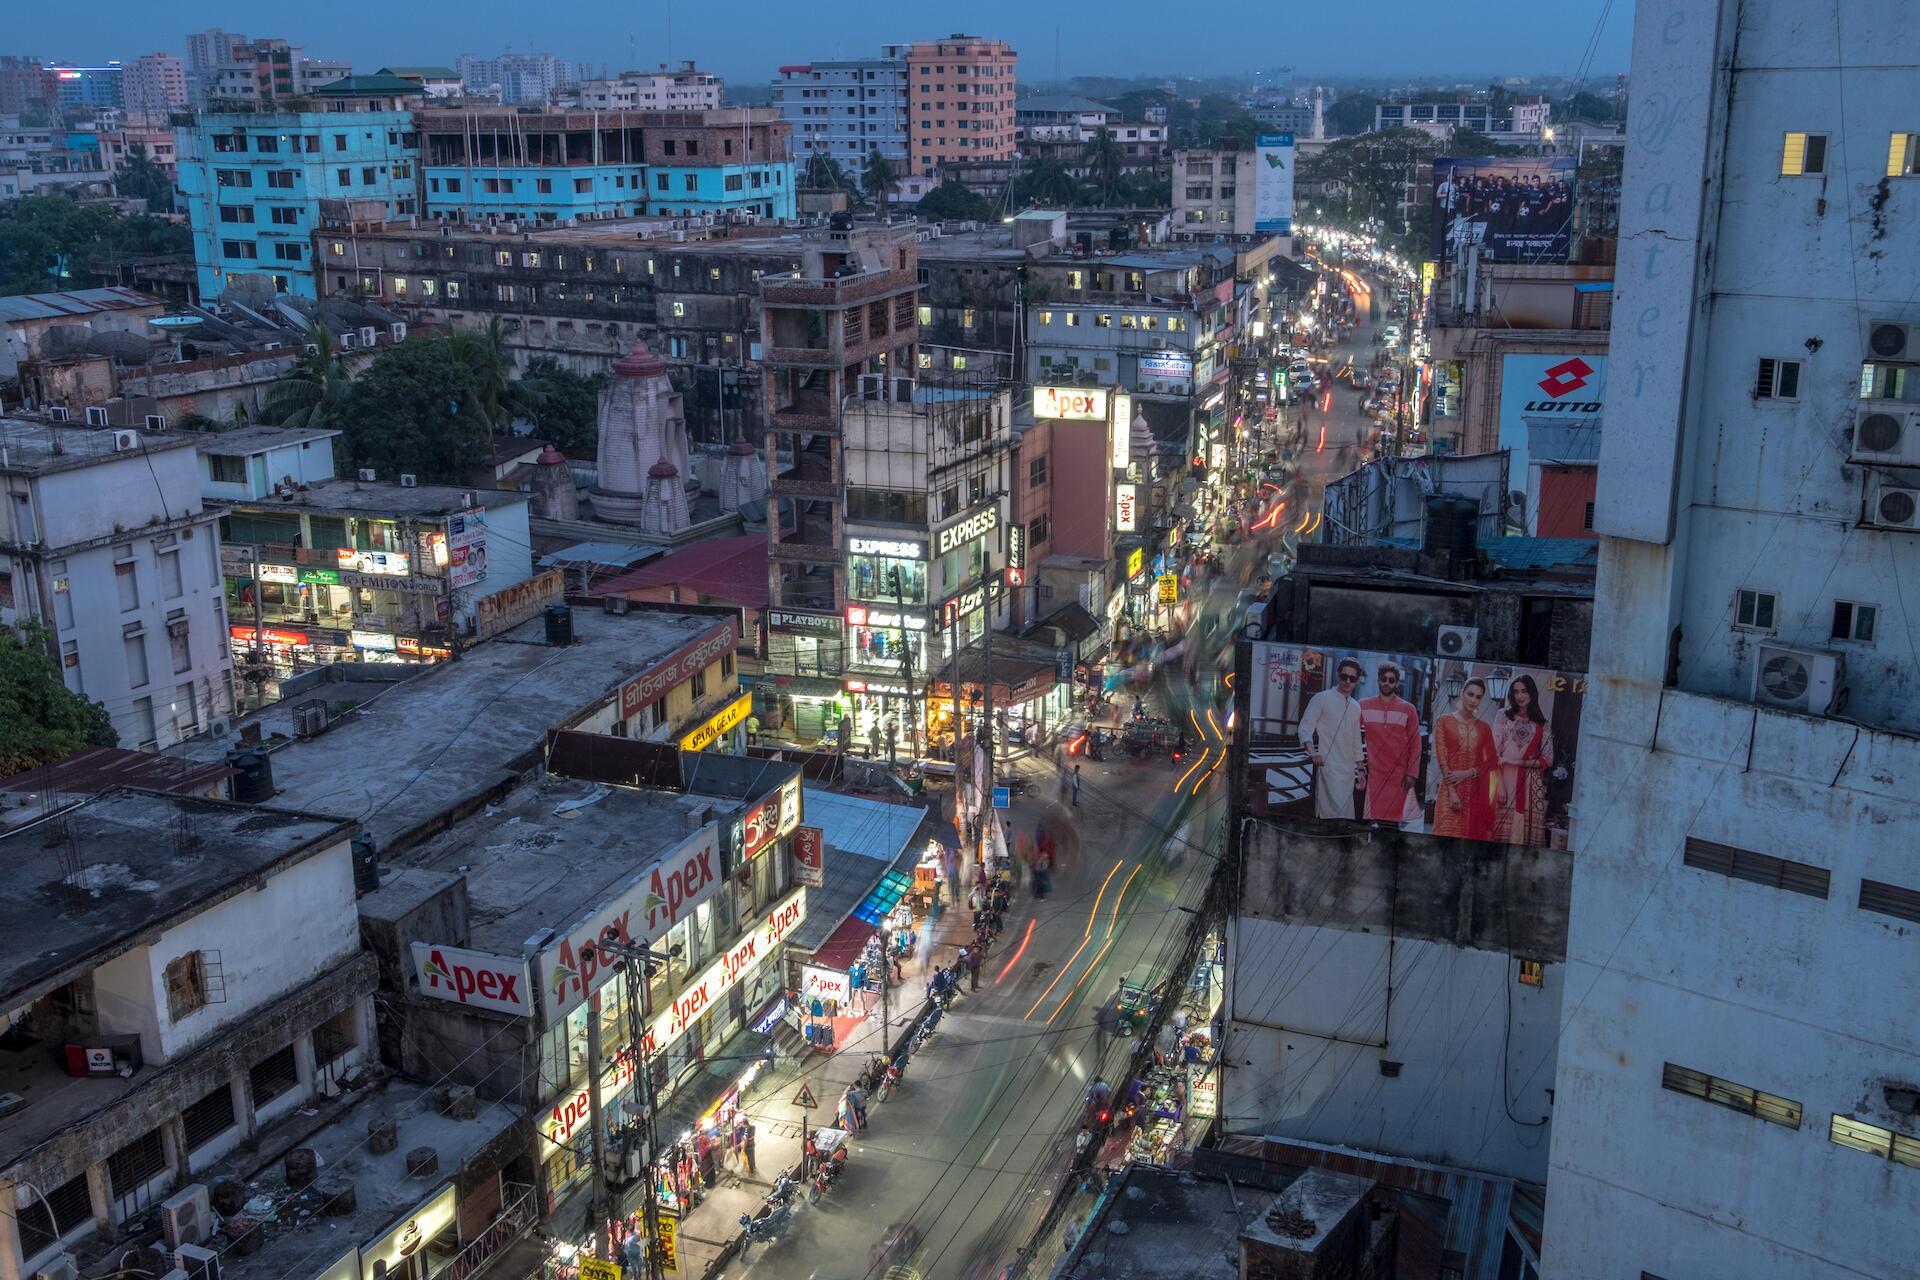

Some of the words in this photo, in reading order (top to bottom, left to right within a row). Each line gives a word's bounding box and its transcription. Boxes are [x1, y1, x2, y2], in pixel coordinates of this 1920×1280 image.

[1045, 388, 1095, 417] Apex
[1525, 400, 1602, 412] LOTTO
[1119, 494, 1134, 522] Apex
[850, 539, 920, 557] EXPRESS
[941, 507, 996, 554] EXPRESS
[361, 577, 410, 590] EMITON
[782, 615, 828, 627] PLAYBOY
[626, 663, 678, 708] প্রীতিরাজ
[692, 721, 716, 748] SPARK
[717, 708, 737, 730] GEAR
[645, 845, 713, 929] Apex
[766, 900, 799, 944] Apex
[424, 950, 520, 1003] Apex
[553, 909, 630, 1006] Apex
[720, 937, 756, 986] Apex
[811, 975, 841, 991] Apex
[670, 983, 708, 1034] Apex
